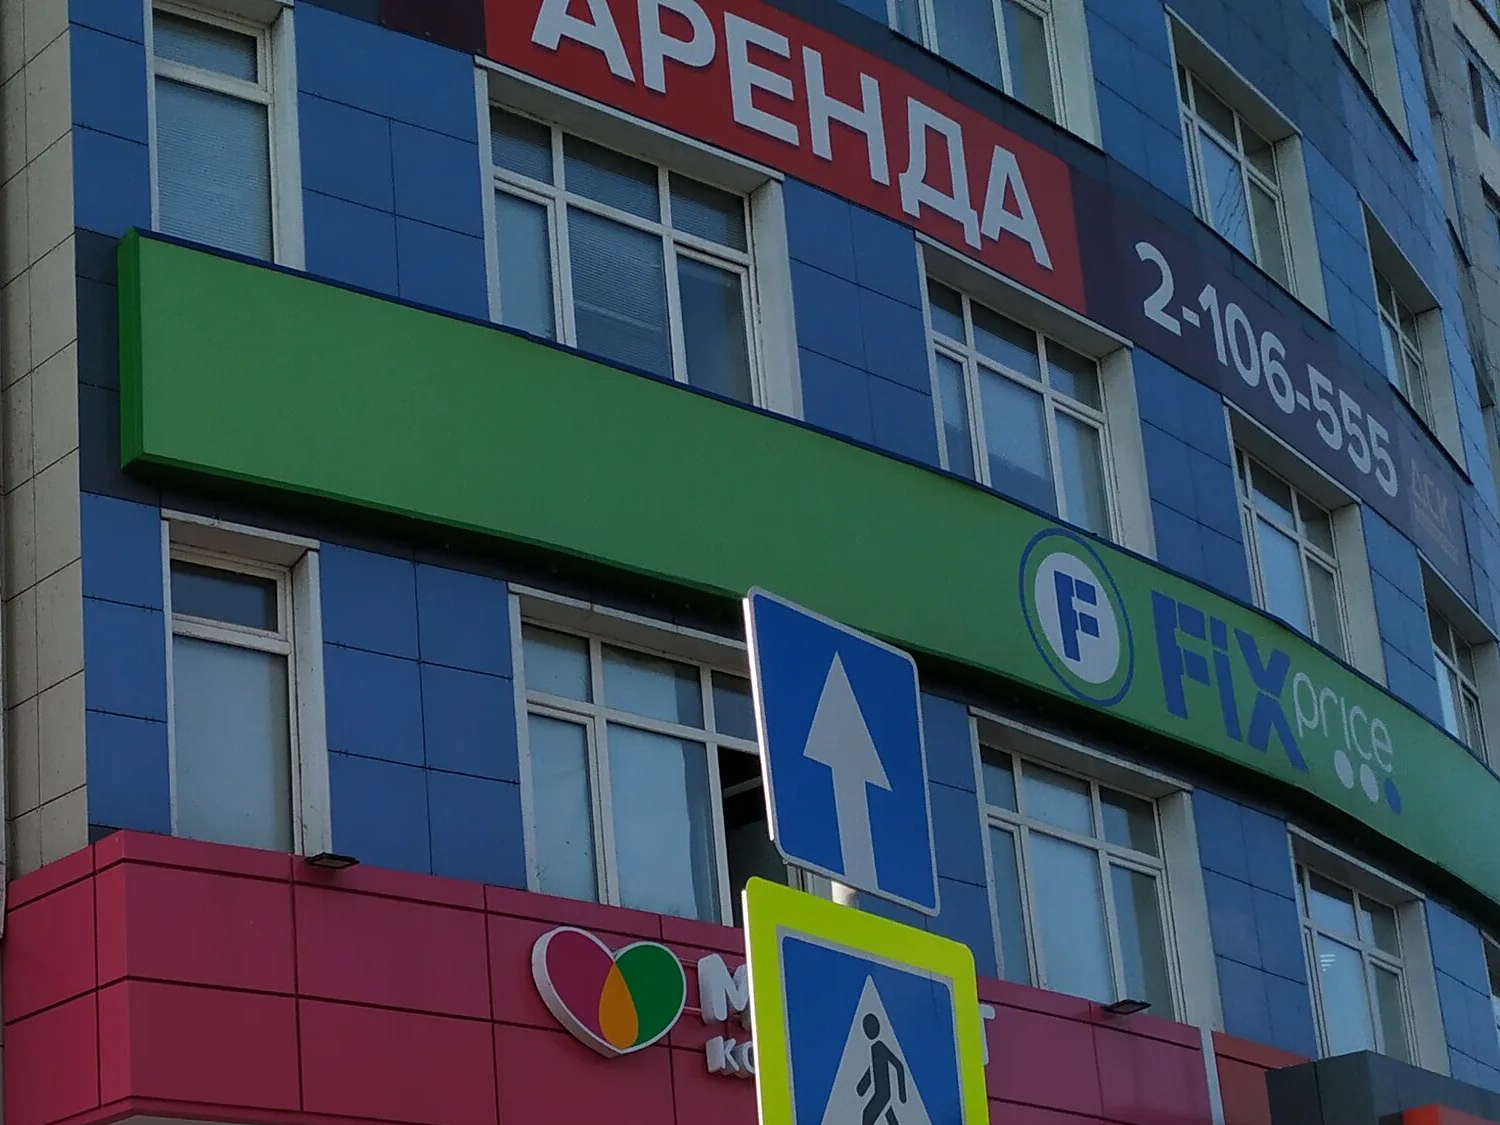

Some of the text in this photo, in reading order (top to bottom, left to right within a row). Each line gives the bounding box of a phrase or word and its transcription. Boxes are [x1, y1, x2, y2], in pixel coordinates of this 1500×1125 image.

[530, 0, 1055, 272] АРЕНДА
[1132, 240, 1400, 498] 2-106-555
[1291, 670, 1394, 773] price
